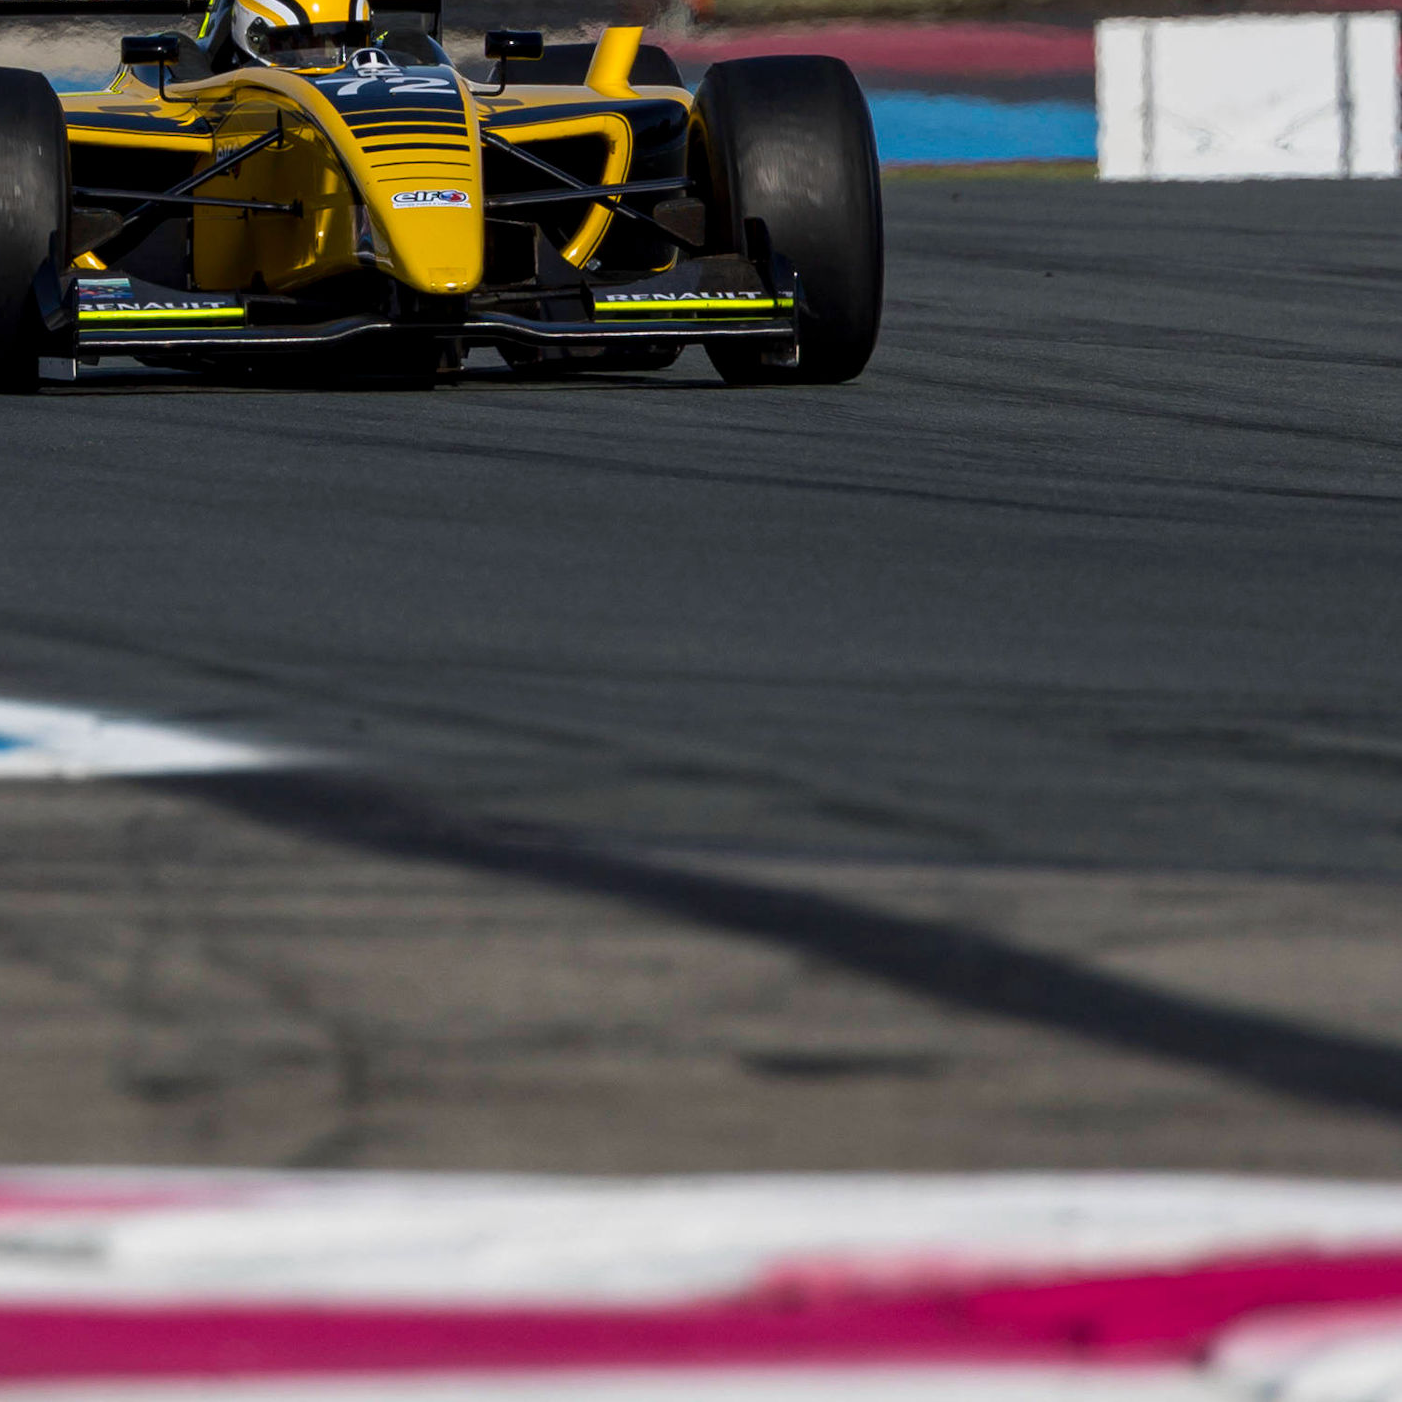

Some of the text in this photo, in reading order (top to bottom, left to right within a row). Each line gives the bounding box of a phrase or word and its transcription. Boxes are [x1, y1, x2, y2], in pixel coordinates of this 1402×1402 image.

[315, 77, 457, 96] 72
[605, 291, 762, 302] RENAULT
[78, 301, 226, 312] RENAULT
